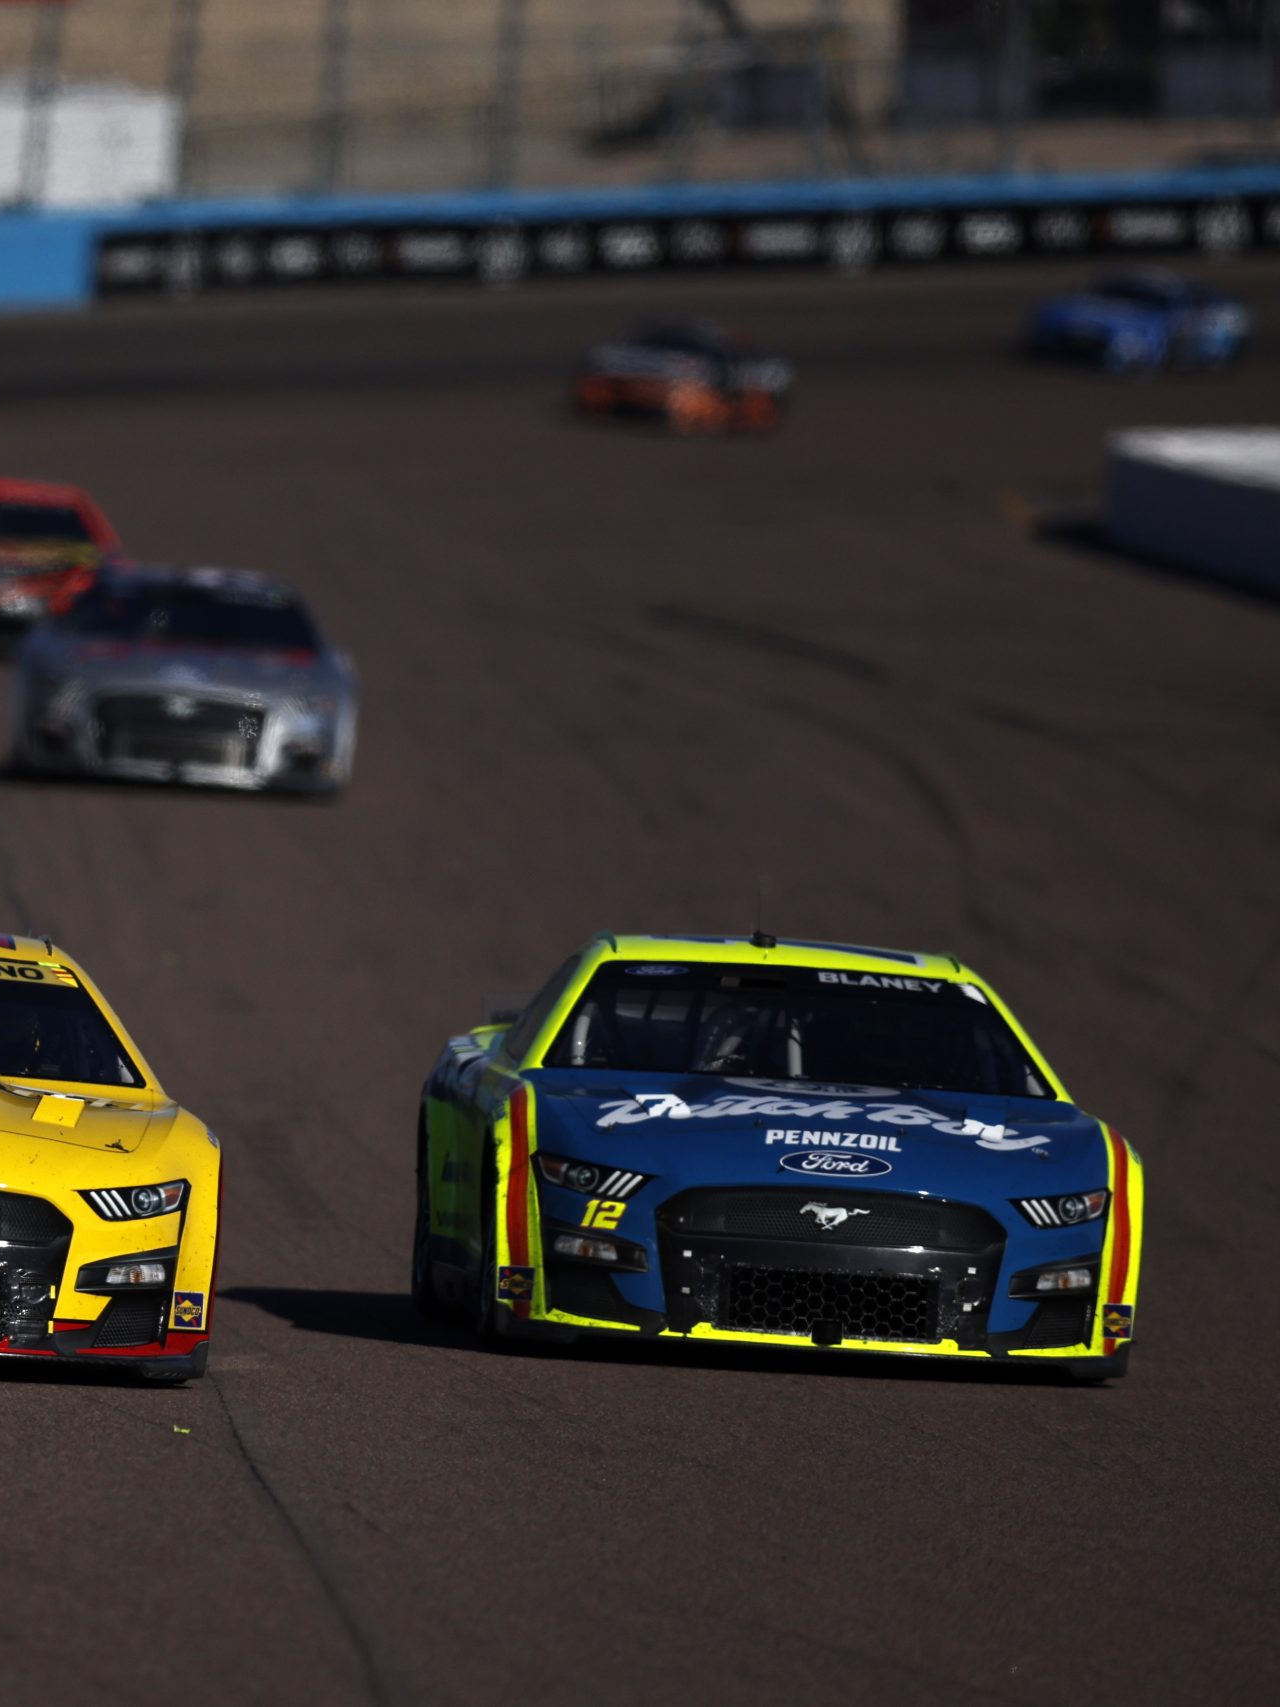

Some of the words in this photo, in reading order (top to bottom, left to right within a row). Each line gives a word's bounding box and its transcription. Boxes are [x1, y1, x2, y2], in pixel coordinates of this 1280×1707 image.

[817, 971, 943, 993] BLANEY
[765, 1129, 902, 1152] PENNZOIL
[801, 1153, 870, 1173] Ford
[580, 1199, 627, 1229] 12
